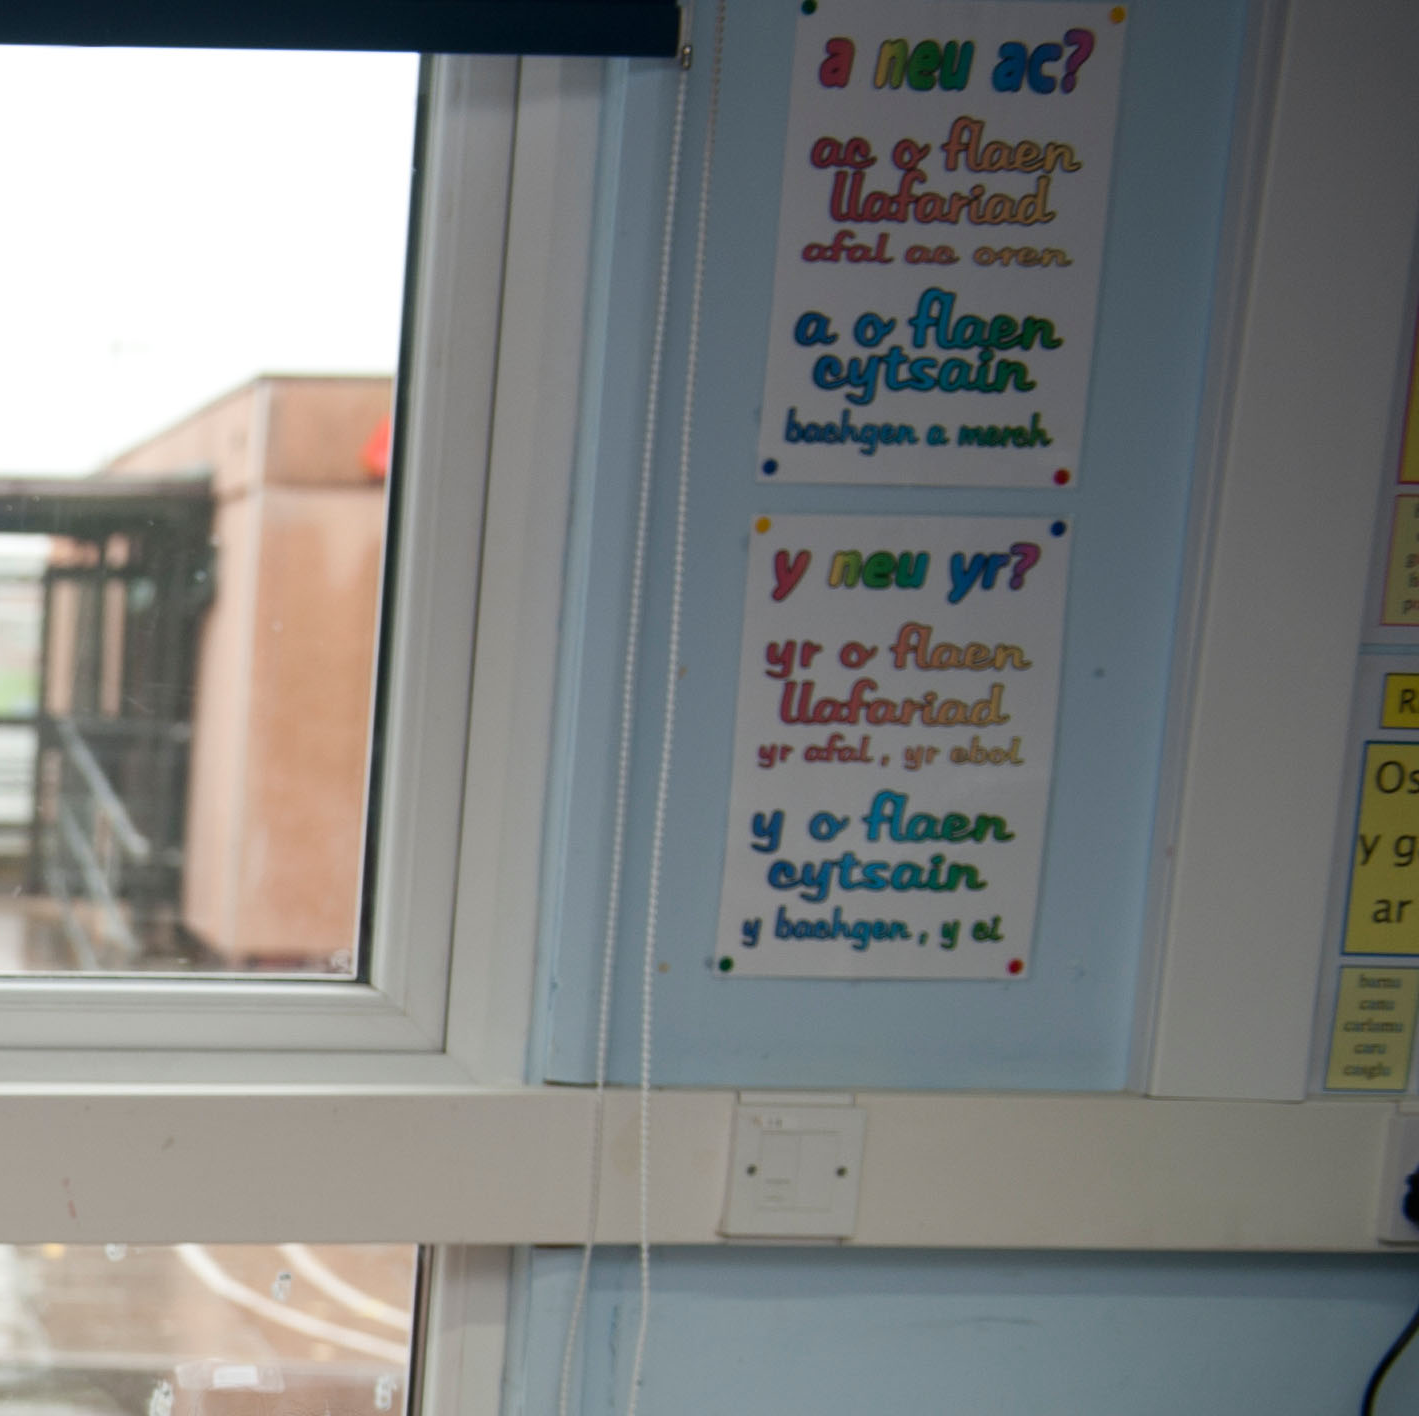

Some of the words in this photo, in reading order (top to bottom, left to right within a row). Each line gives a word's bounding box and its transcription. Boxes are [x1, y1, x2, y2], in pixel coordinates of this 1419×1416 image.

[818, 36, 856, 88] a
[873, 38, 975, 92] neu
[991, 28, 1095, 95] ac?
[810, 136, 877, 170] ac
[891, 138, 931, 170] o
[942, 115, 1082, 173] flaen
[829, 168, 1056, 226] llafariad
[801, 229, 895, 264] afal
[904, 244, 961, 265] ac
[972, 244, 1073, 268] oren
[793, 310, 839, 348] a
[852, 312, 897, 348] o
[909, 287, 1064, 351] flaen
[812, 345, 1037, 405] cytsain
[783, 406, 920, 457] bachgen
[926, 423, 950, 446] a
[957, 412, 1053, 448] merch
[771, 549, 812, 602] y
[828, 550, 930, 589] neu
[946, 541, 1041, 606] yr?
[765, 639, 823, 679] yr
[839, 640, 878, 669] o
[889, 621, 1033, 671] flaen
[778, 677, 1011, 727] llafariad
[757, 743, 795, 769] yr
[903, 743, 941, 771] yr
[950, 735, 1026, 766] ebol
[750, 809, 785, 853] y
[808, 811, 850, 843] o
[862, 788, 1016, 843] flaen
[1358, 833, 1381, 866] y
[767, 852, 989, 902] cytsain
[741, 917, 763, 947] y
[940, 917, 961, 950] y
[971, 915, 1005, 943] ci
[1372, 898, 1412, 923] ar
